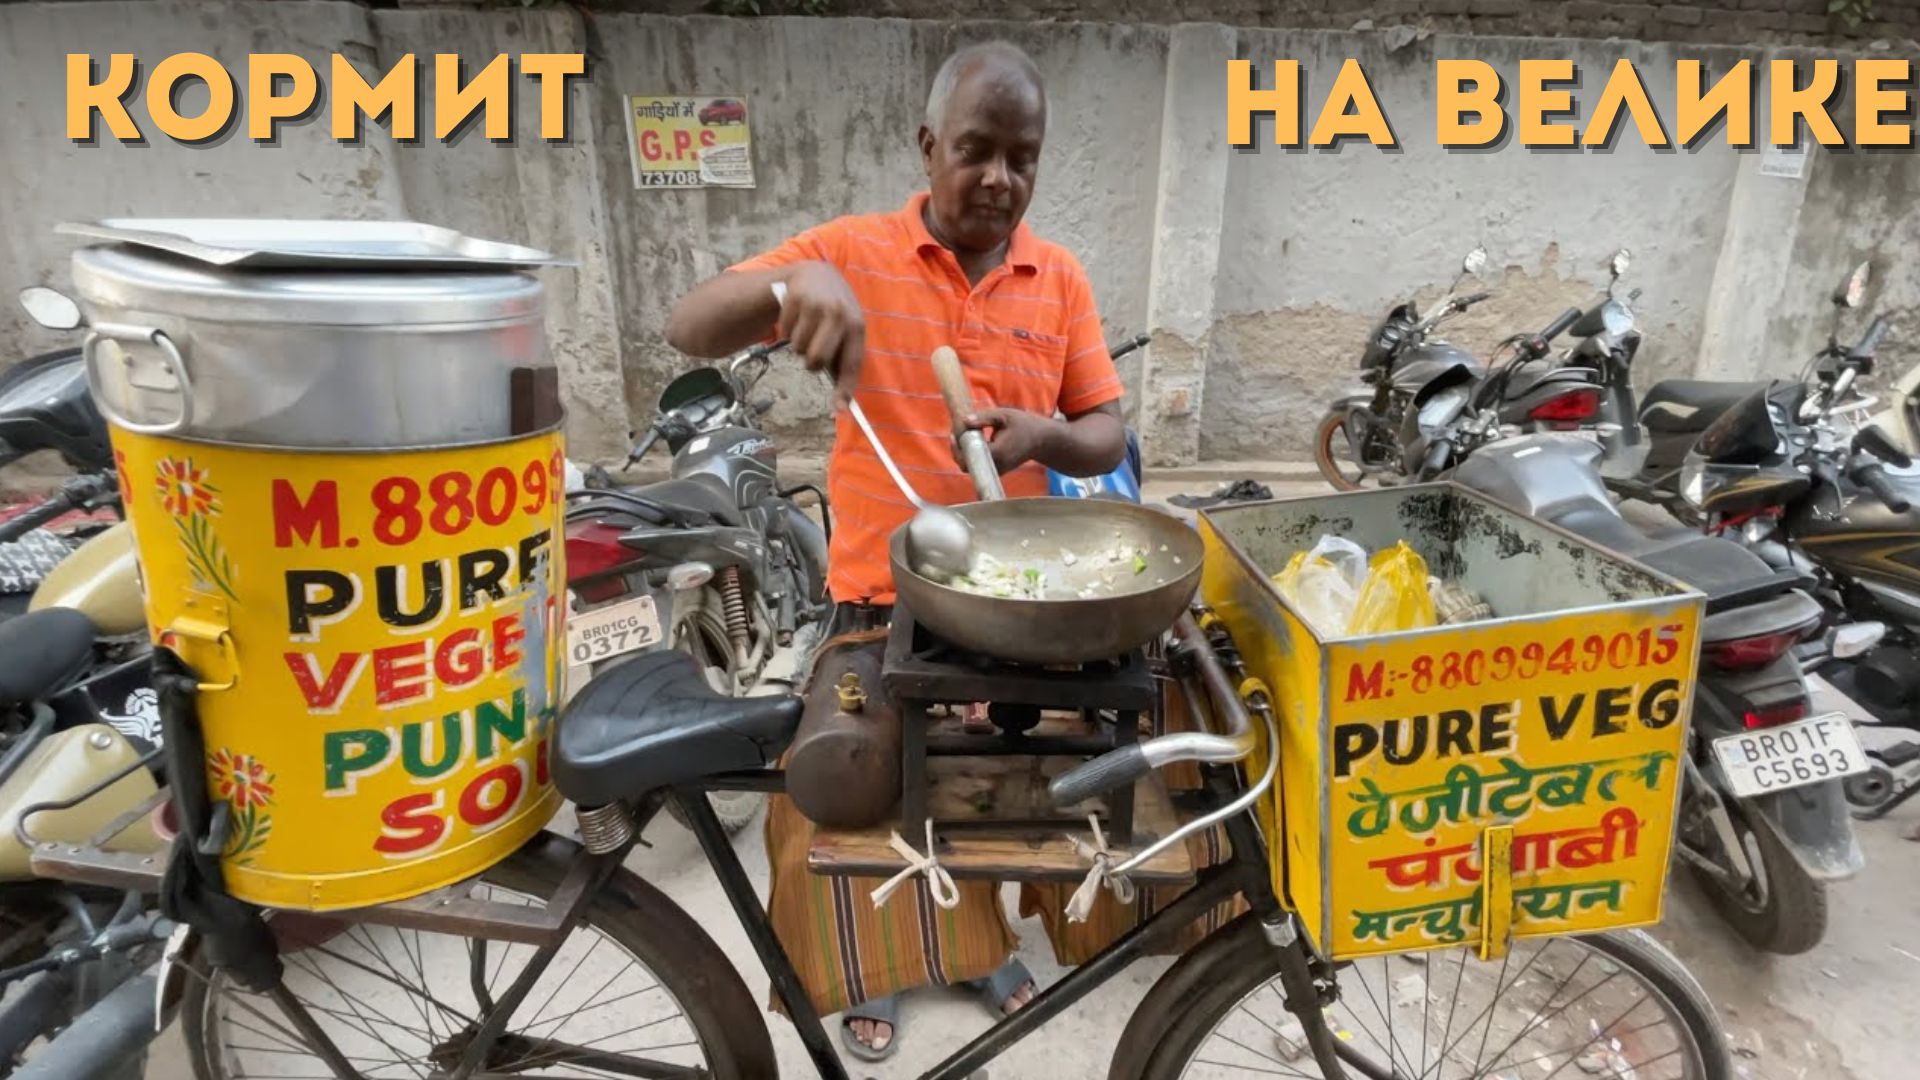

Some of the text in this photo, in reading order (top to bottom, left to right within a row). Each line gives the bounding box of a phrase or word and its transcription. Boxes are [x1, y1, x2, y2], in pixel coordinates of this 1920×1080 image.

[642, 171, 704, 185] 73708
[573, 626, 652, 662] 0372
[582, 616, 638, 641] BR01CG
[1334, 678, 1682, 780] PURE VEG
[1740, 721, 1830, 763] BR01F
[1753, 748, 1849, 788] C5693
